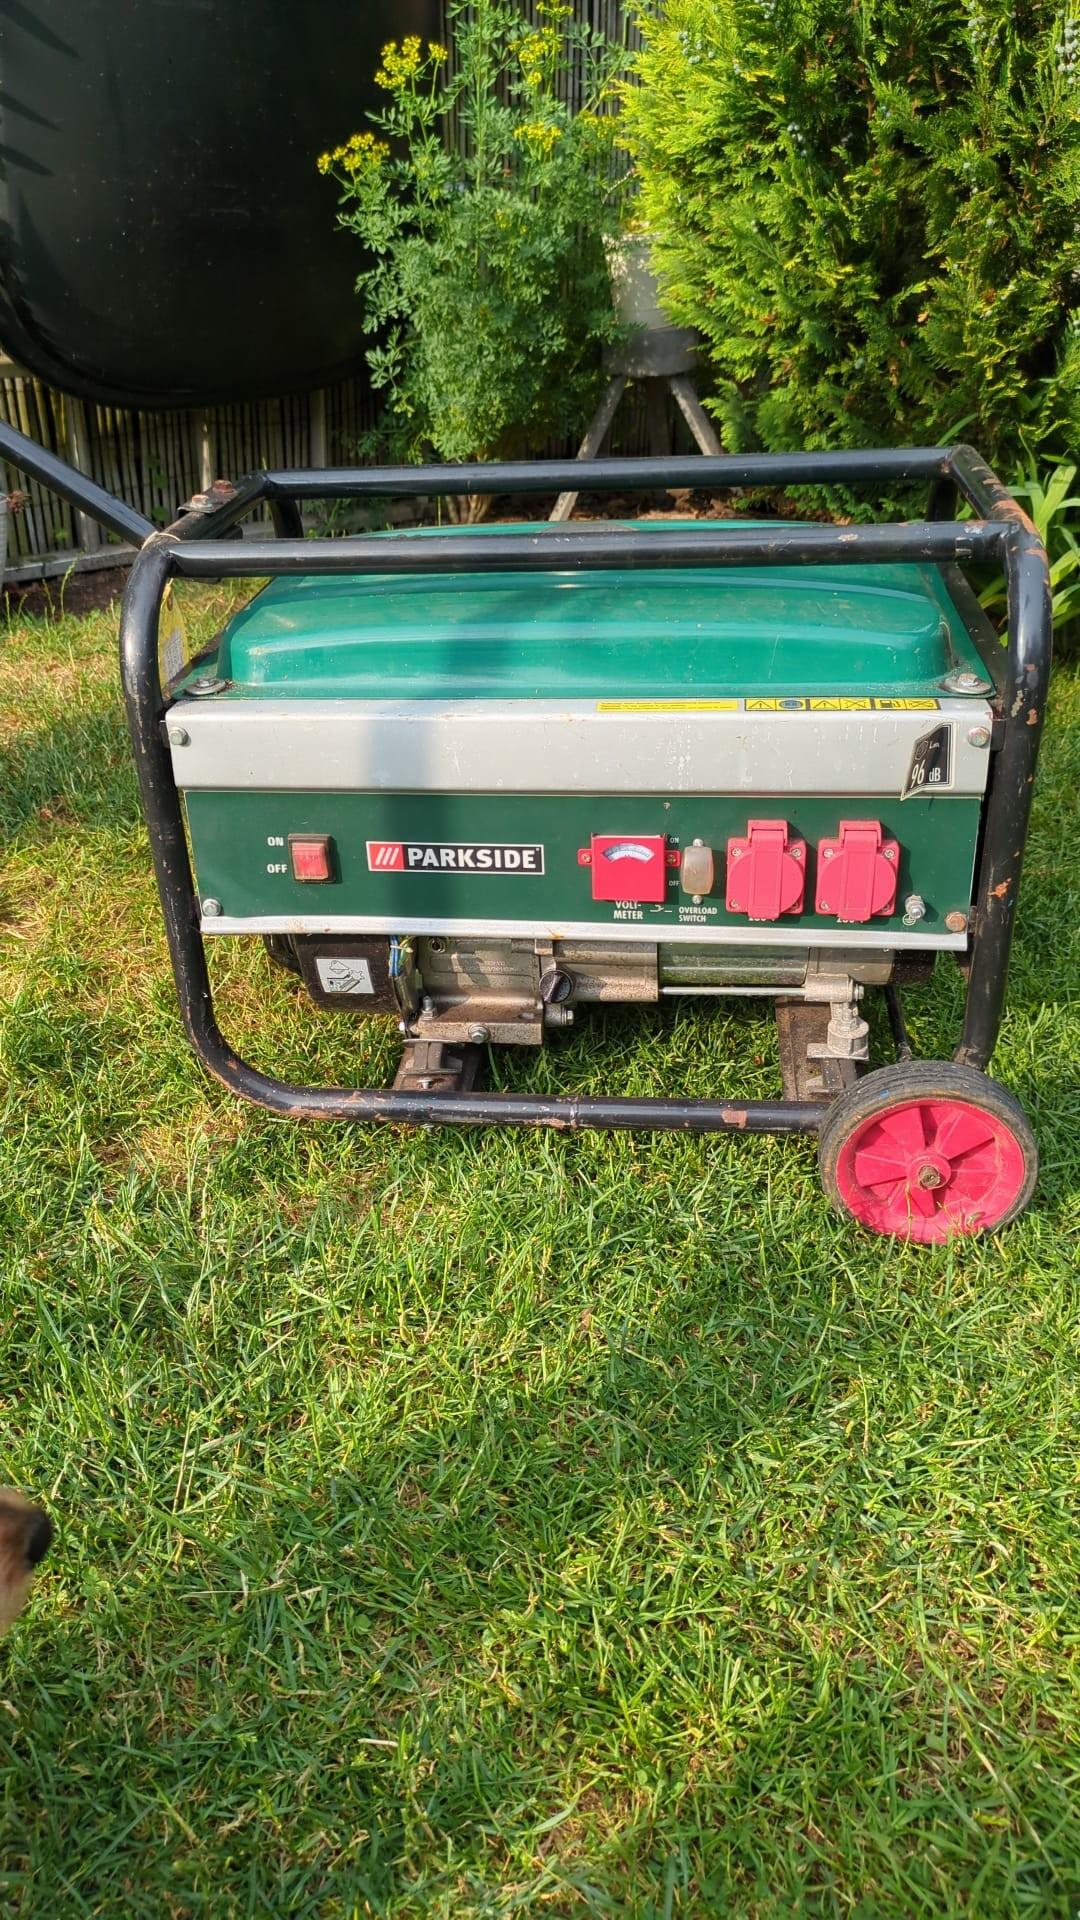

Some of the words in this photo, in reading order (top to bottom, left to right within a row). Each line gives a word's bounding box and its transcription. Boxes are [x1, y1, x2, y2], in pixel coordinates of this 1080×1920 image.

[910, 759, 926, 789] 96
[928, 767, 941, 782] dB
[267, 836, 284, 847] ON
[407, 847, 537, 870] PARKSIDE
[267, 863, 288, 874] OFF
[613, 910, 644, 920] METER
[678, 906, 718, 915] OVERLOAD
[678, 914, 707, 923] SWITCH
